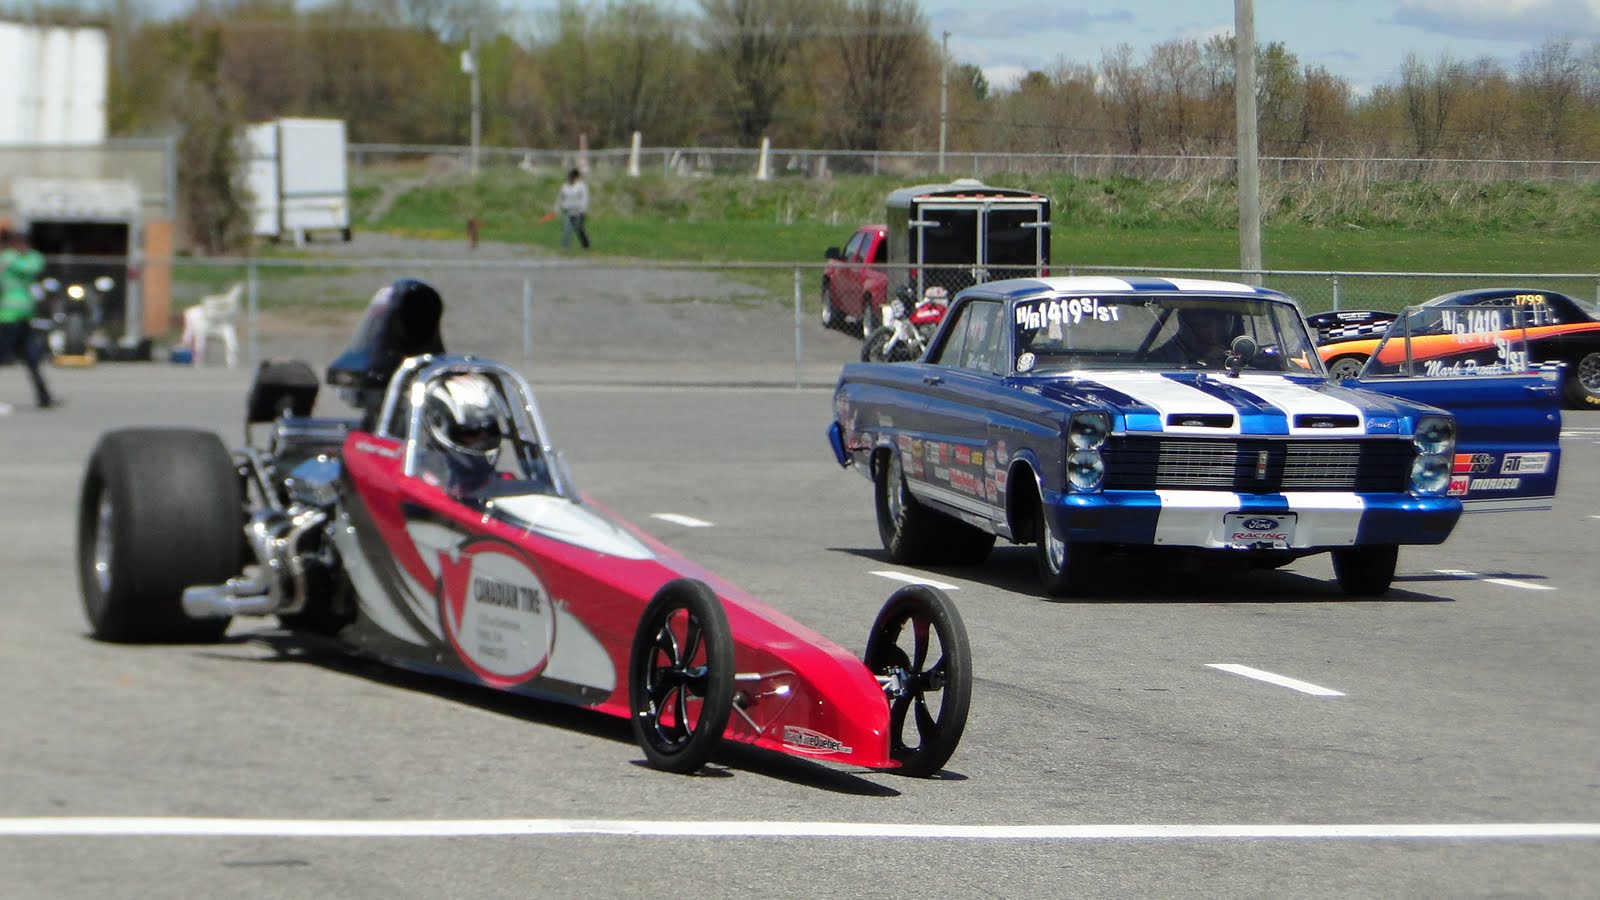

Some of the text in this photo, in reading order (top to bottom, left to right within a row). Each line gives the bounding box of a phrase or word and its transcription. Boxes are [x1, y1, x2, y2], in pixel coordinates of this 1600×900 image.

[1515, 294, 1544, 305] 1799
[1424, 360, 1459, 377] Mark
[1469, 478, 1520, 490] MOROSO
[1249, 519, 1271, 530] Ford
[1232, 532, 1288, 541] RACING
[474, 577, 540, 614] CANADIAN TIRE
